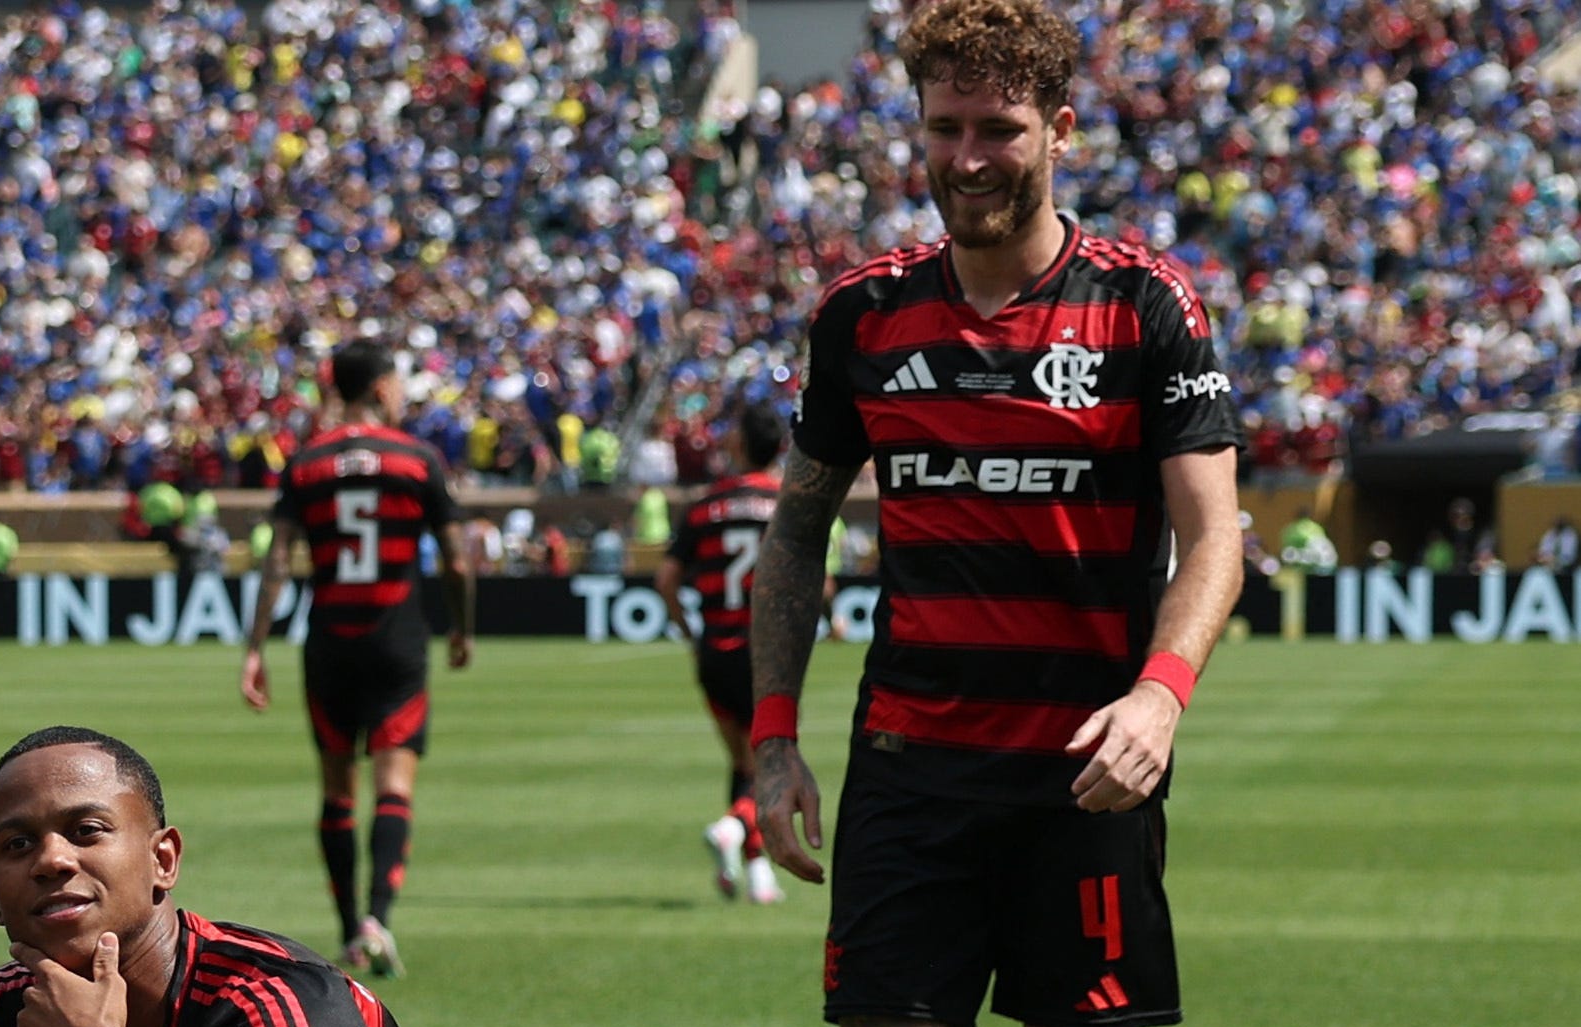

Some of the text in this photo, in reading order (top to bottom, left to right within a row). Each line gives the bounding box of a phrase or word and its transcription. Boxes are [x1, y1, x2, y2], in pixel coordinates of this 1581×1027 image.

[890, 453, 1092, 493] FLABET
[334, 488, 380, 584] 5
[722, 528, 760, 610] 7
[18, 572, 110, 646] IN
[1270, 566, 1581, 644] 1 IN JA
[1079, 875, 1124, 961] 4
